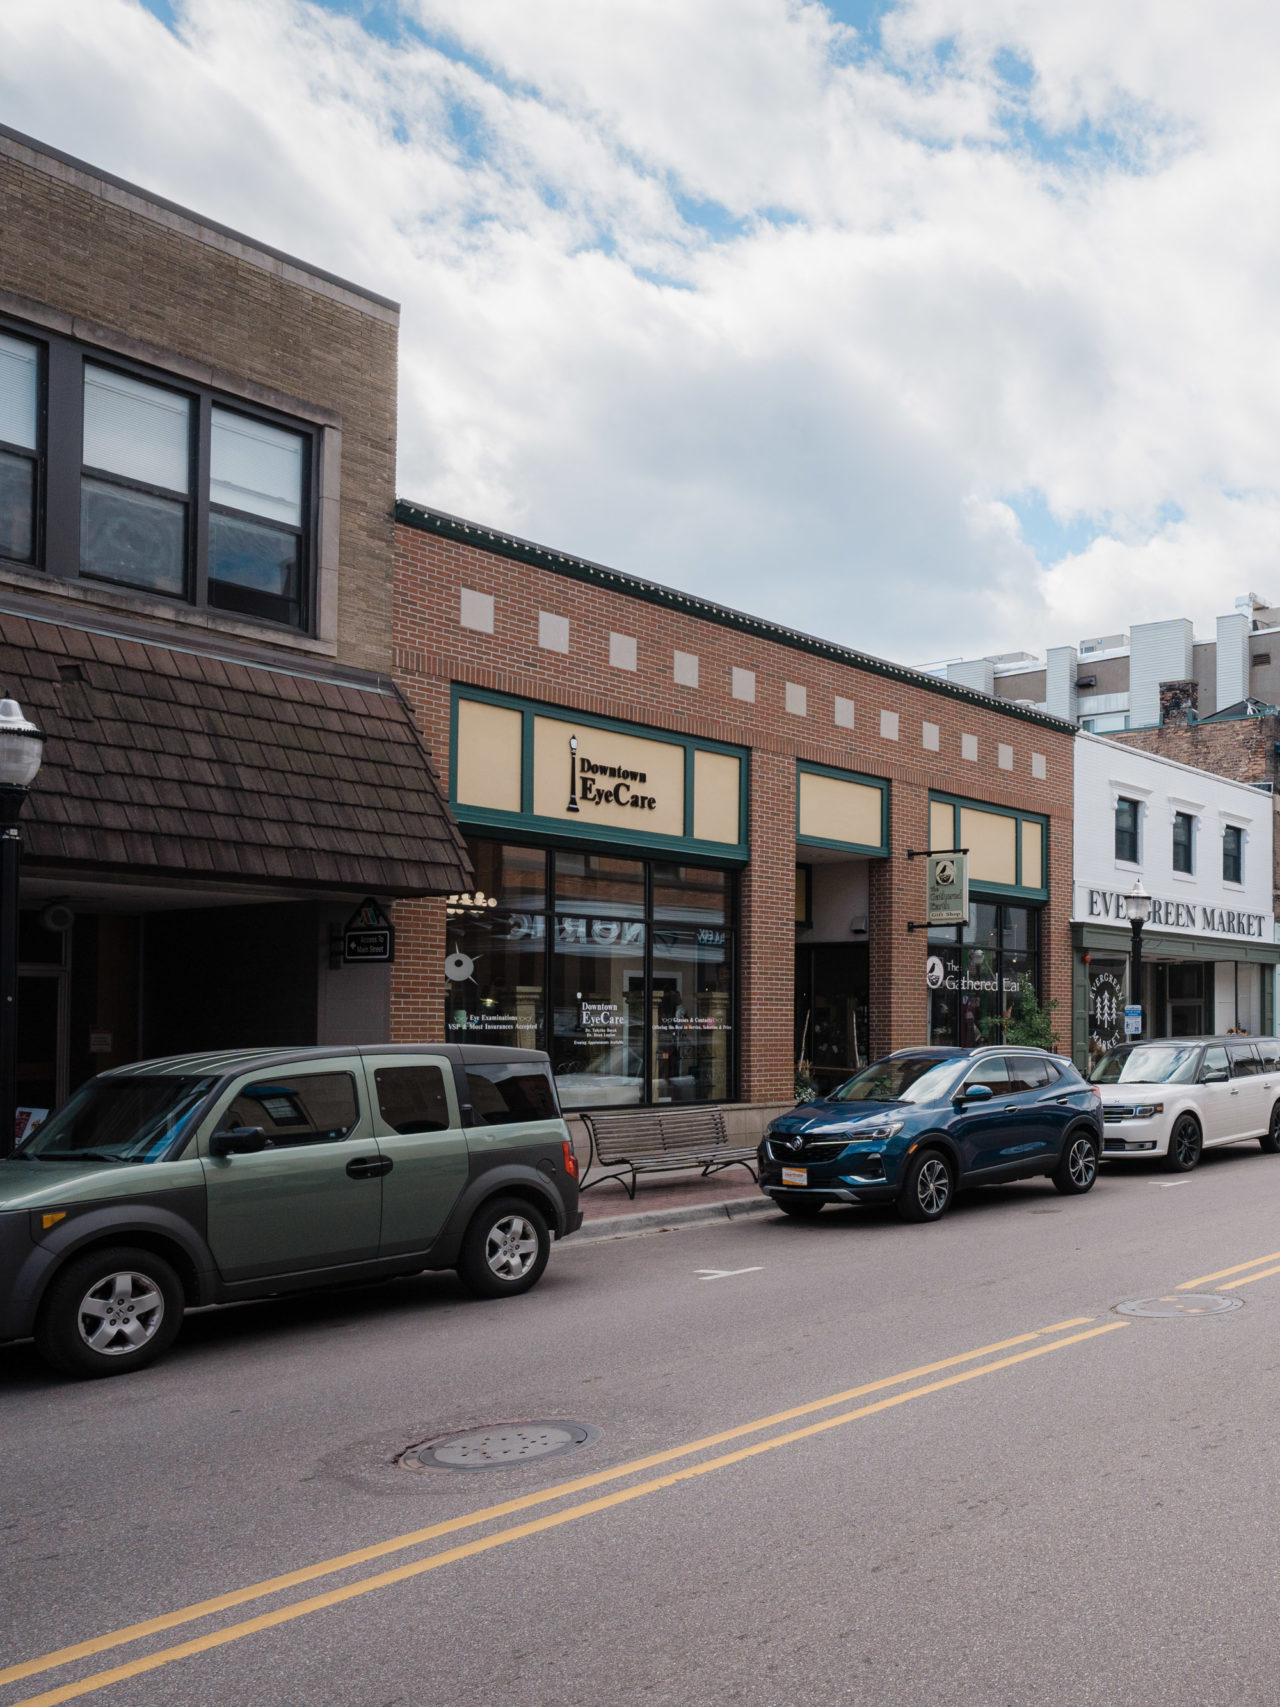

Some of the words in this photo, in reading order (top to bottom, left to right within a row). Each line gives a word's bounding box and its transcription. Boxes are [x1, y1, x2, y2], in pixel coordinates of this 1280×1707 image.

[580, 757, 647, 783] Downtown
[580, 776, 656, 810] EyeCare
[1089, 889, 1196, 928] EVEREEN
[1202, 907, 1266, 937] MARKET
[946, 960, 959, 972] The
[945, 970, 999, 992] Gathered
[1090, 972, 1124, 1001] EVERGREEN
[482, 1013, 518, 1021] Examinations
[582, 1002, 618, 1011] Downtown
[582, 1011, 625, 1026] EyeCare
[1092, 1030, 1120, 1050] MARKET
